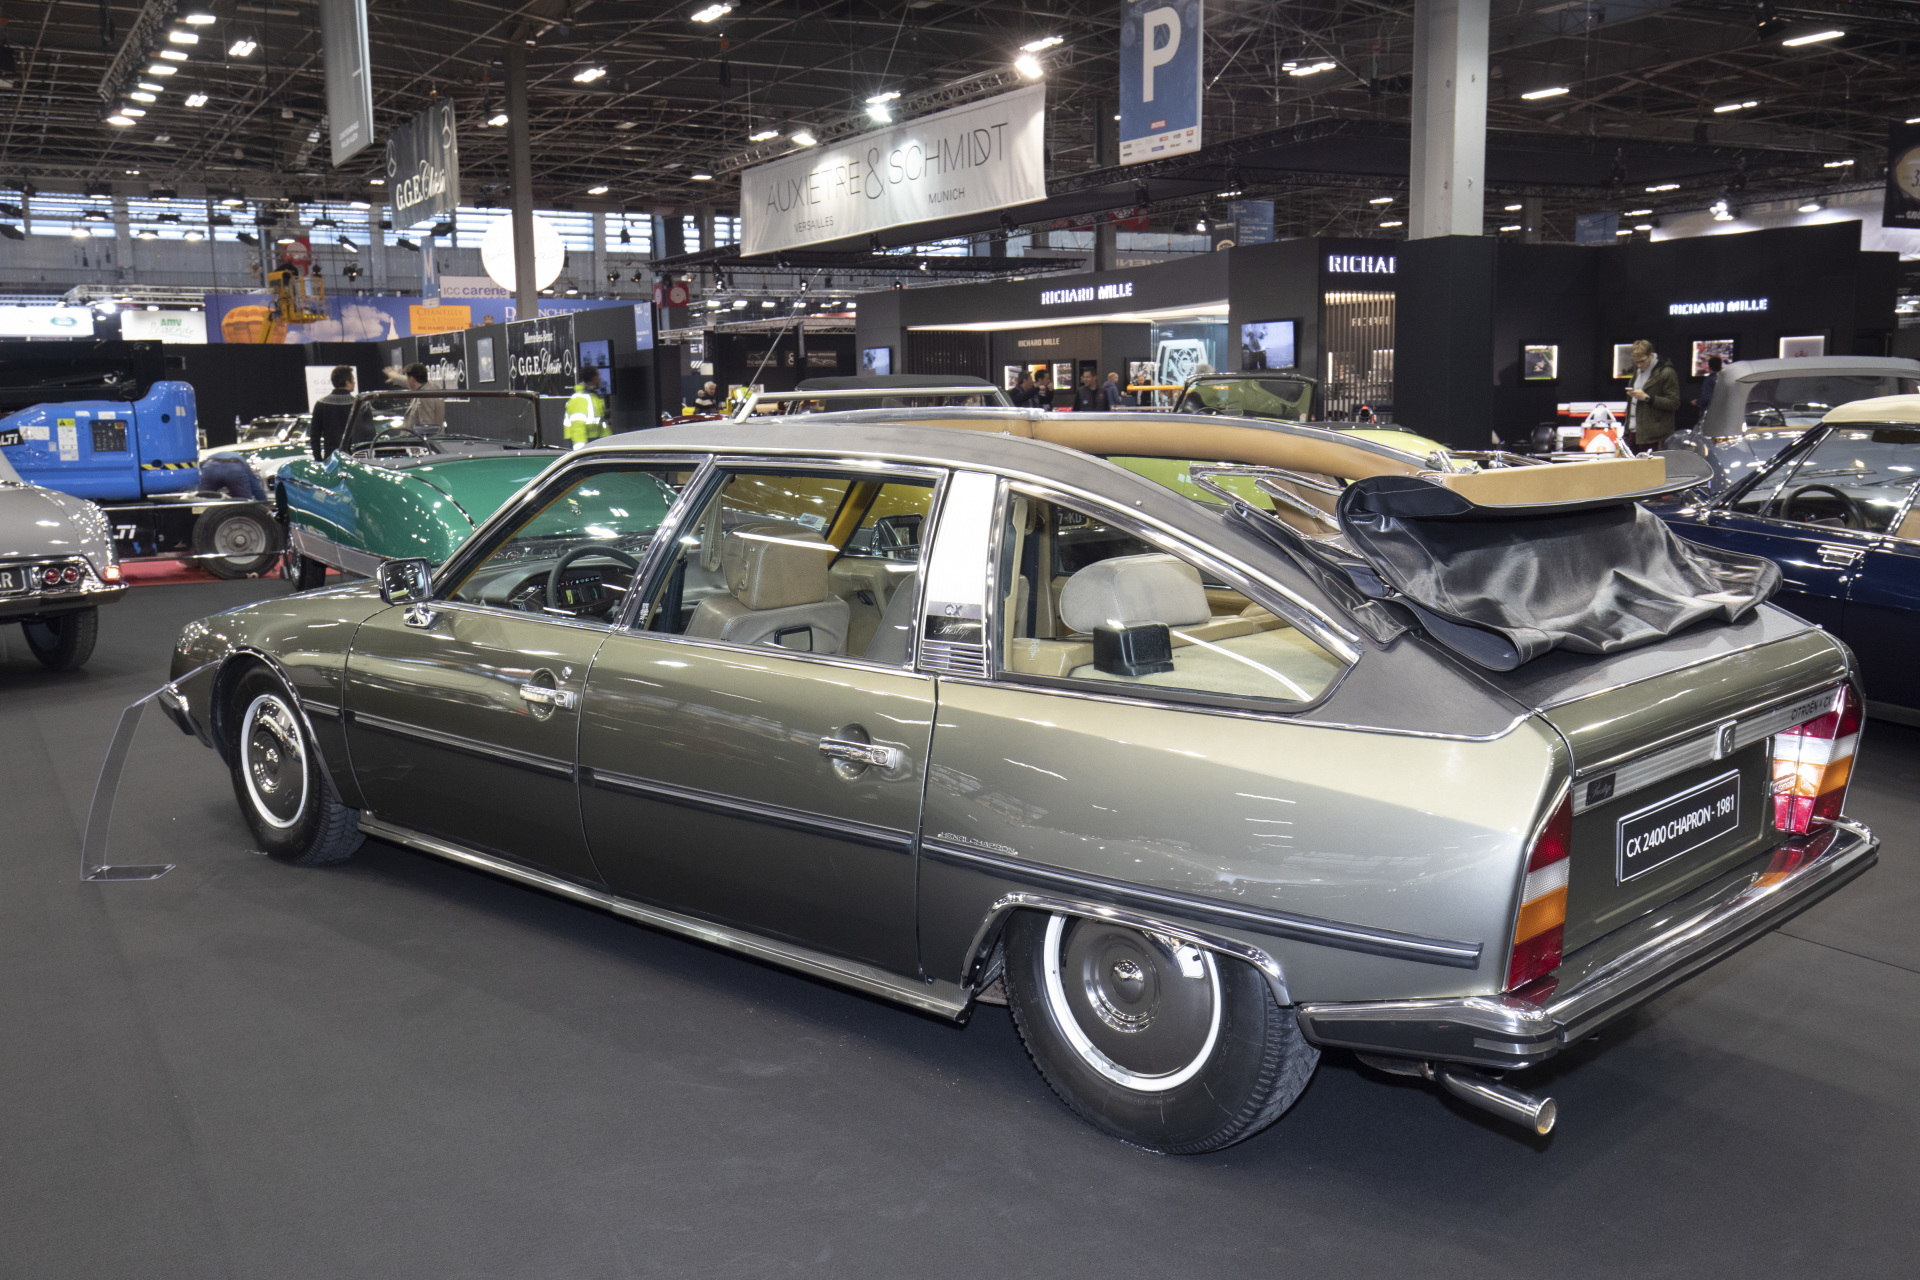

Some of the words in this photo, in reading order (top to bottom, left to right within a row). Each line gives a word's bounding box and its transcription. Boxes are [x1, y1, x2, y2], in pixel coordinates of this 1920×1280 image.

[1143, 6, 1182, 103] P
[765, 160, 861, 215] AUXIETRE
[864, 147, 886, 200] &
[888, 122, 1008, 184] SCHMIDT
[928, 187, 965, 204] MUNICH
[794, 215, 834, 233] VERSAILLES
[424, 247, 435, 286] M
[443, 286, 461, 296] ICC
[462, 286, 507, 296] carene
[1041, 287, 1094, 305] RICHARD
[1098, 282, 1133, 300] MILLE
[1669, 301, 1725, 315] RICHARD
[1726, 298, 1768, 312] MILLE
[523, 329, 553, 345] Mercedes-Benz
[1017, 338, 1042, 348] RICHARD
[1042, 337, 1060, 347] MILLE
[518, 355, 542, 376] G.G.E.
[945, 604, 963, 617] CX
[934, 623, 971, 640] Prestige
[1823, 697, 1833, 708] CX
[1626, 835, 1642, 858] CX
[1642, 825, 1667, 852] 2400
[1667, 805, 1711, 839] CHAPRON
[1716, 794, 1735, 818] 1981
